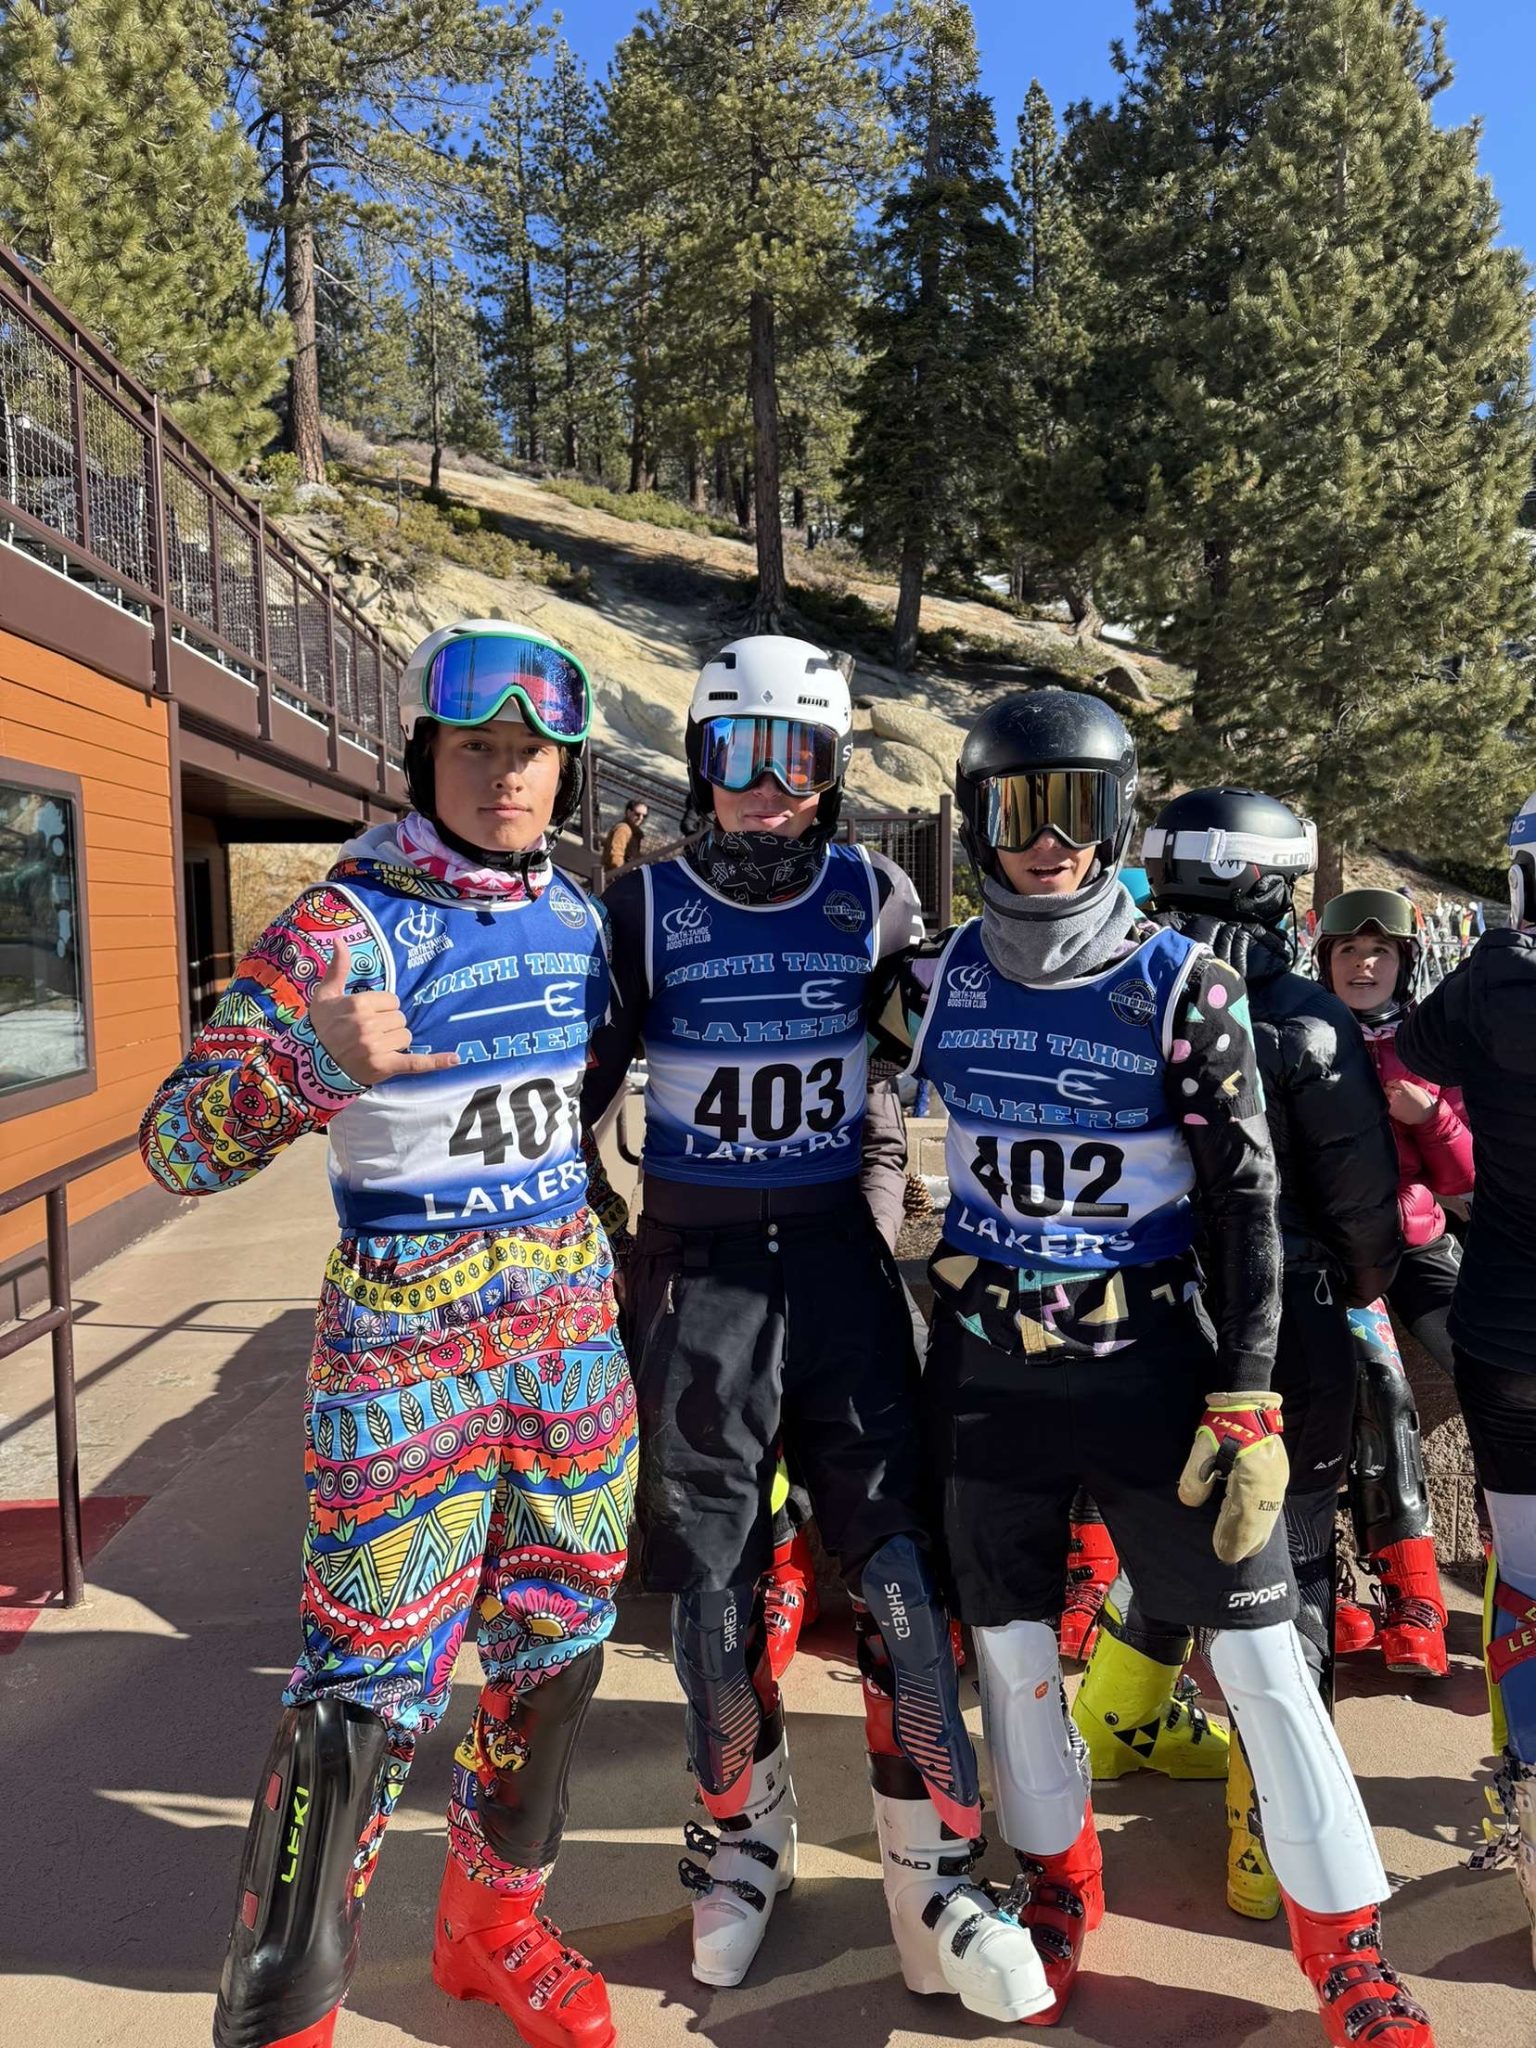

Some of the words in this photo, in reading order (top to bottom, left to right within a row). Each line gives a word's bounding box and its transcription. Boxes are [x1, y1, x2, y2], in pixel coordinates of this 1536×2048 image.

[435, 937, 454, 954] CLUB
[694, 933, 711, 944] CLUB
[413, 956, 518, 1007] NORTH
[525, 952, 601, 977] TAHOE
[665, 953, 774, 987] NORTH
[972, 999, 987, 1009] CLUB
[672, 1006, 859, 1043] LAKERS
[938, 1028, 1037, 1052] NORTH
[1047, 1033, 1157, 1076] TAHOE
[694, 1057, 846, 1143] 403
[943, 1082, 1149, 1129] LAKERS
[684, 1125, 851, 1164] LAKERS
[970, 1135, 1129, 1218] 402
[957, 1207, 1136, 1258] LAKERS
[1212, 1416, 1255, 1439] LEKI
[1228, 1582, 1288, 1608] SPYDER
[1508, 1628, 1536, 1652] LE
[281, 1786, 310, 1883] LEKI
